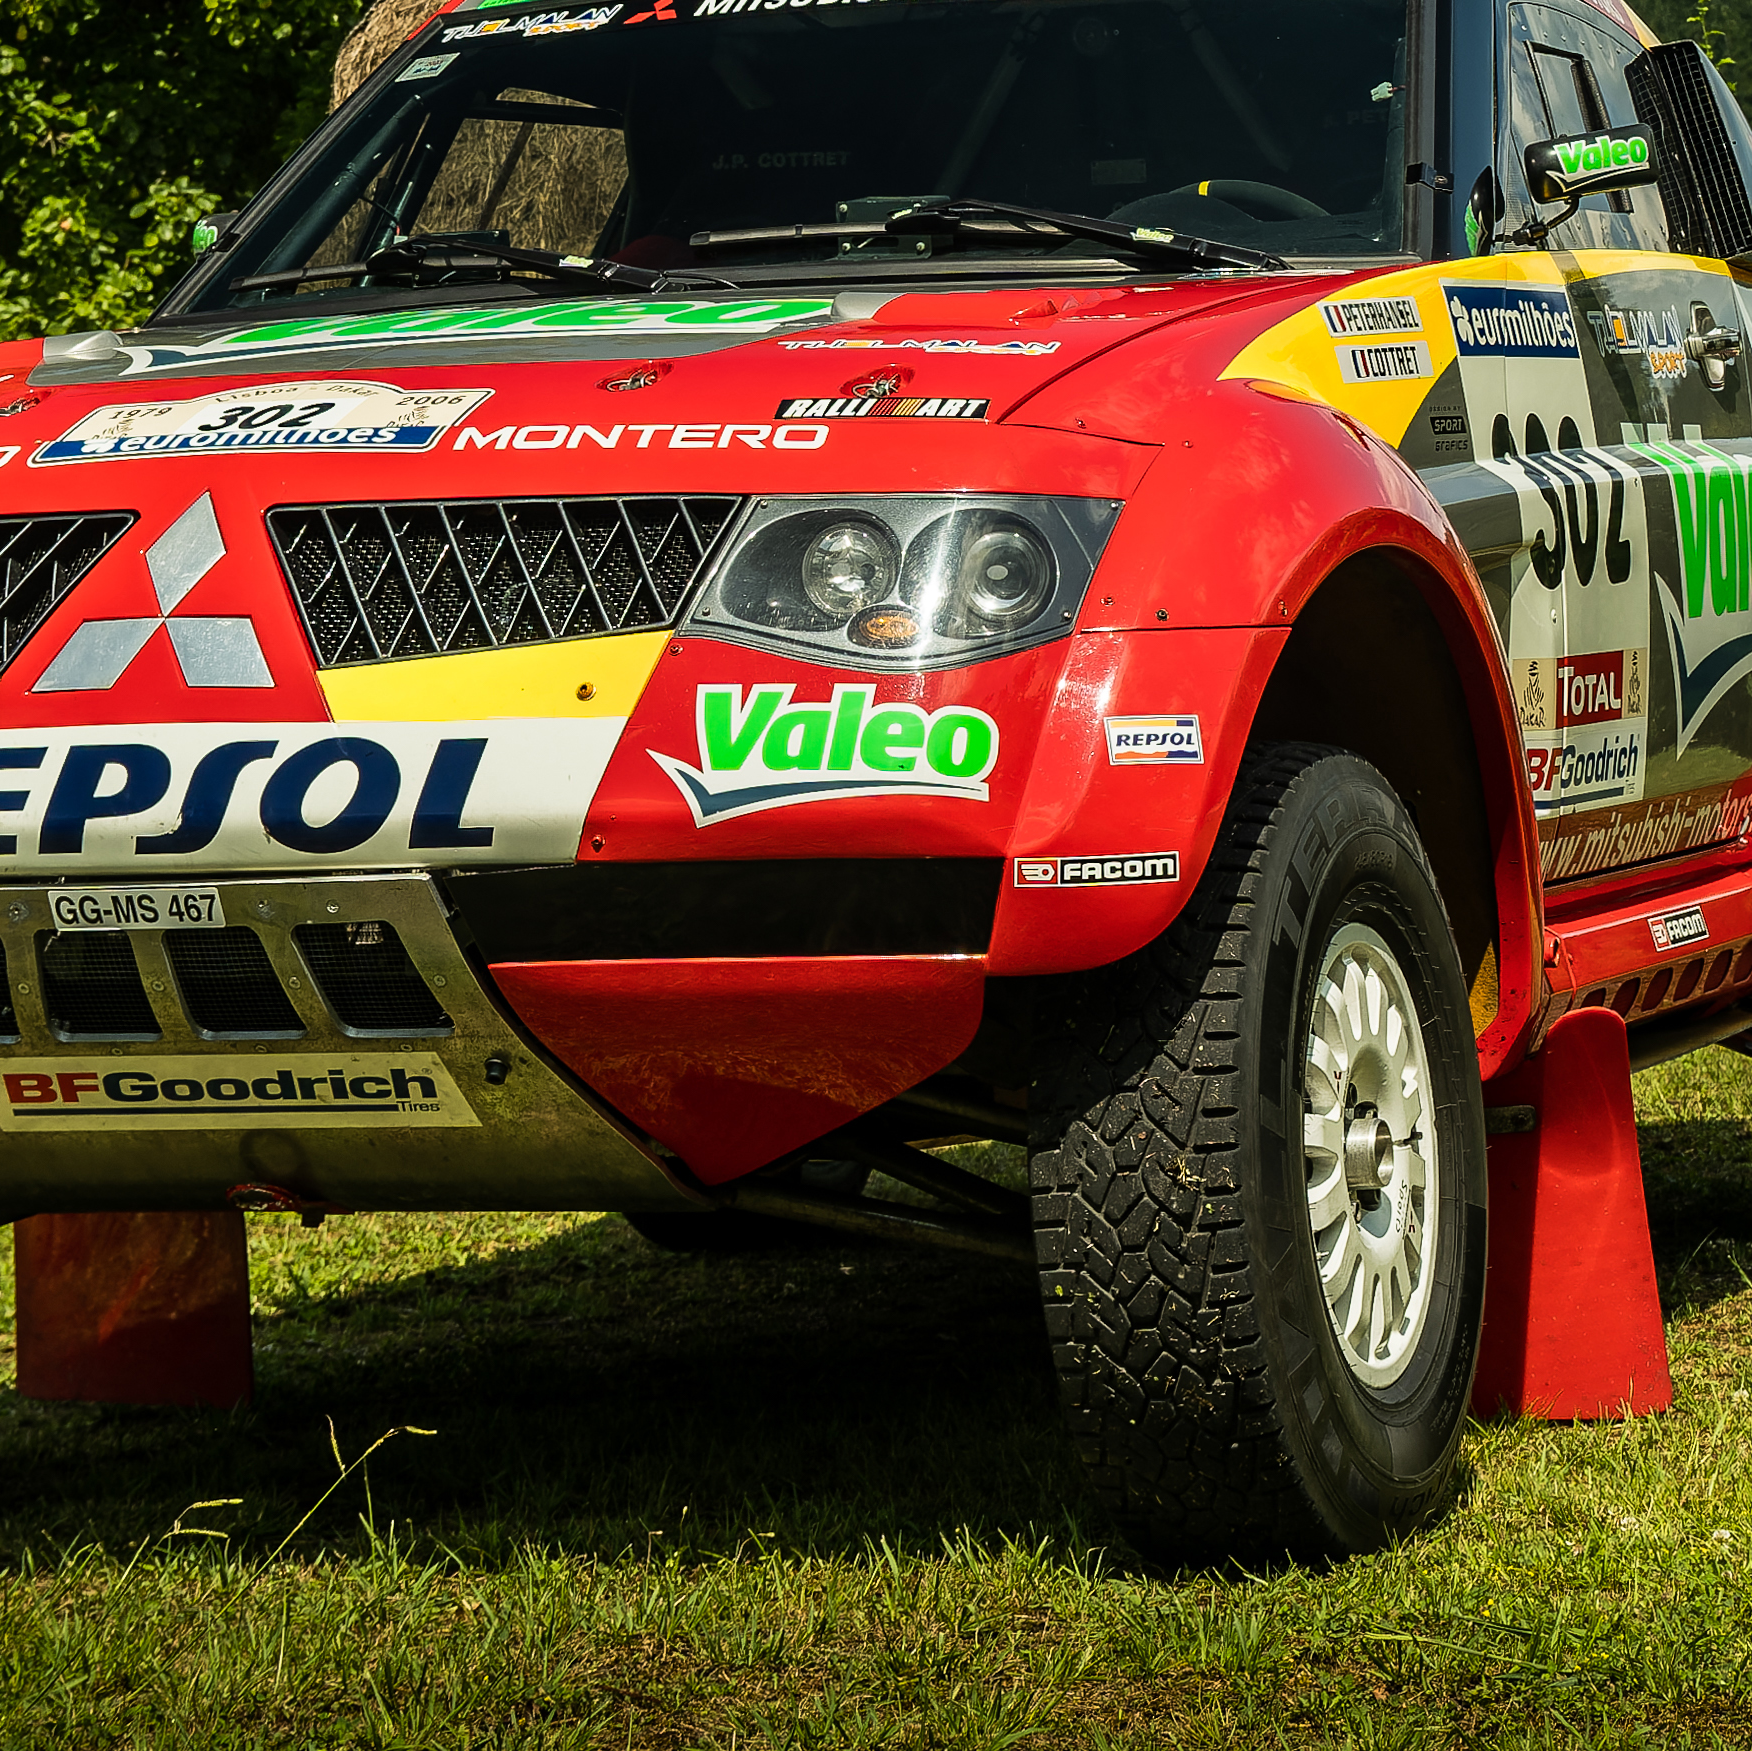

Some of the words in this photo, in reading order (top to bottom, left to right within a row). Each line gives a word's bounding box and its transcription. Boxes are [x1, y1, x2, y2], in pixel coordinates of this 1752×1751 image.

[757, 151, 852, 168] COTTRET
[1555, 137, 1648, 175] Valeo
[1343, 300, 1419, 331] PETERHANSEL
[1368, 345, 1421, 377] COTTRET
[108, 406, 173, 420] 1979
[395, 395, 467, 406] 2006
[215, 386, 298, 403] Lisboa
[325, 384, 379, 397] Dakar
[198, 402, 335, 432] 302
[1434, 418, 1463, 432] SPORT
[452, 423, 831, 451] MONTERO
[1492, 412, 1631, 590] 302
[1557, 666, 1622, 717] TOTAL
[704, 691, 992, 778] Valeo
[1115, 732, 1195, 747] REPSOL
[1526, 733, 1639, 791] BFGoodrich
[1063, 857, 1175, 881] FACOM
[54, 893, 160, 925] GG-MS
[168, 893, 216, 922] 467
[1666, 913, 1706, 939] FACOM
[2, 1067, 438, 1104] BFGoodrich
[398, 1101, 441, 1113] Tires
